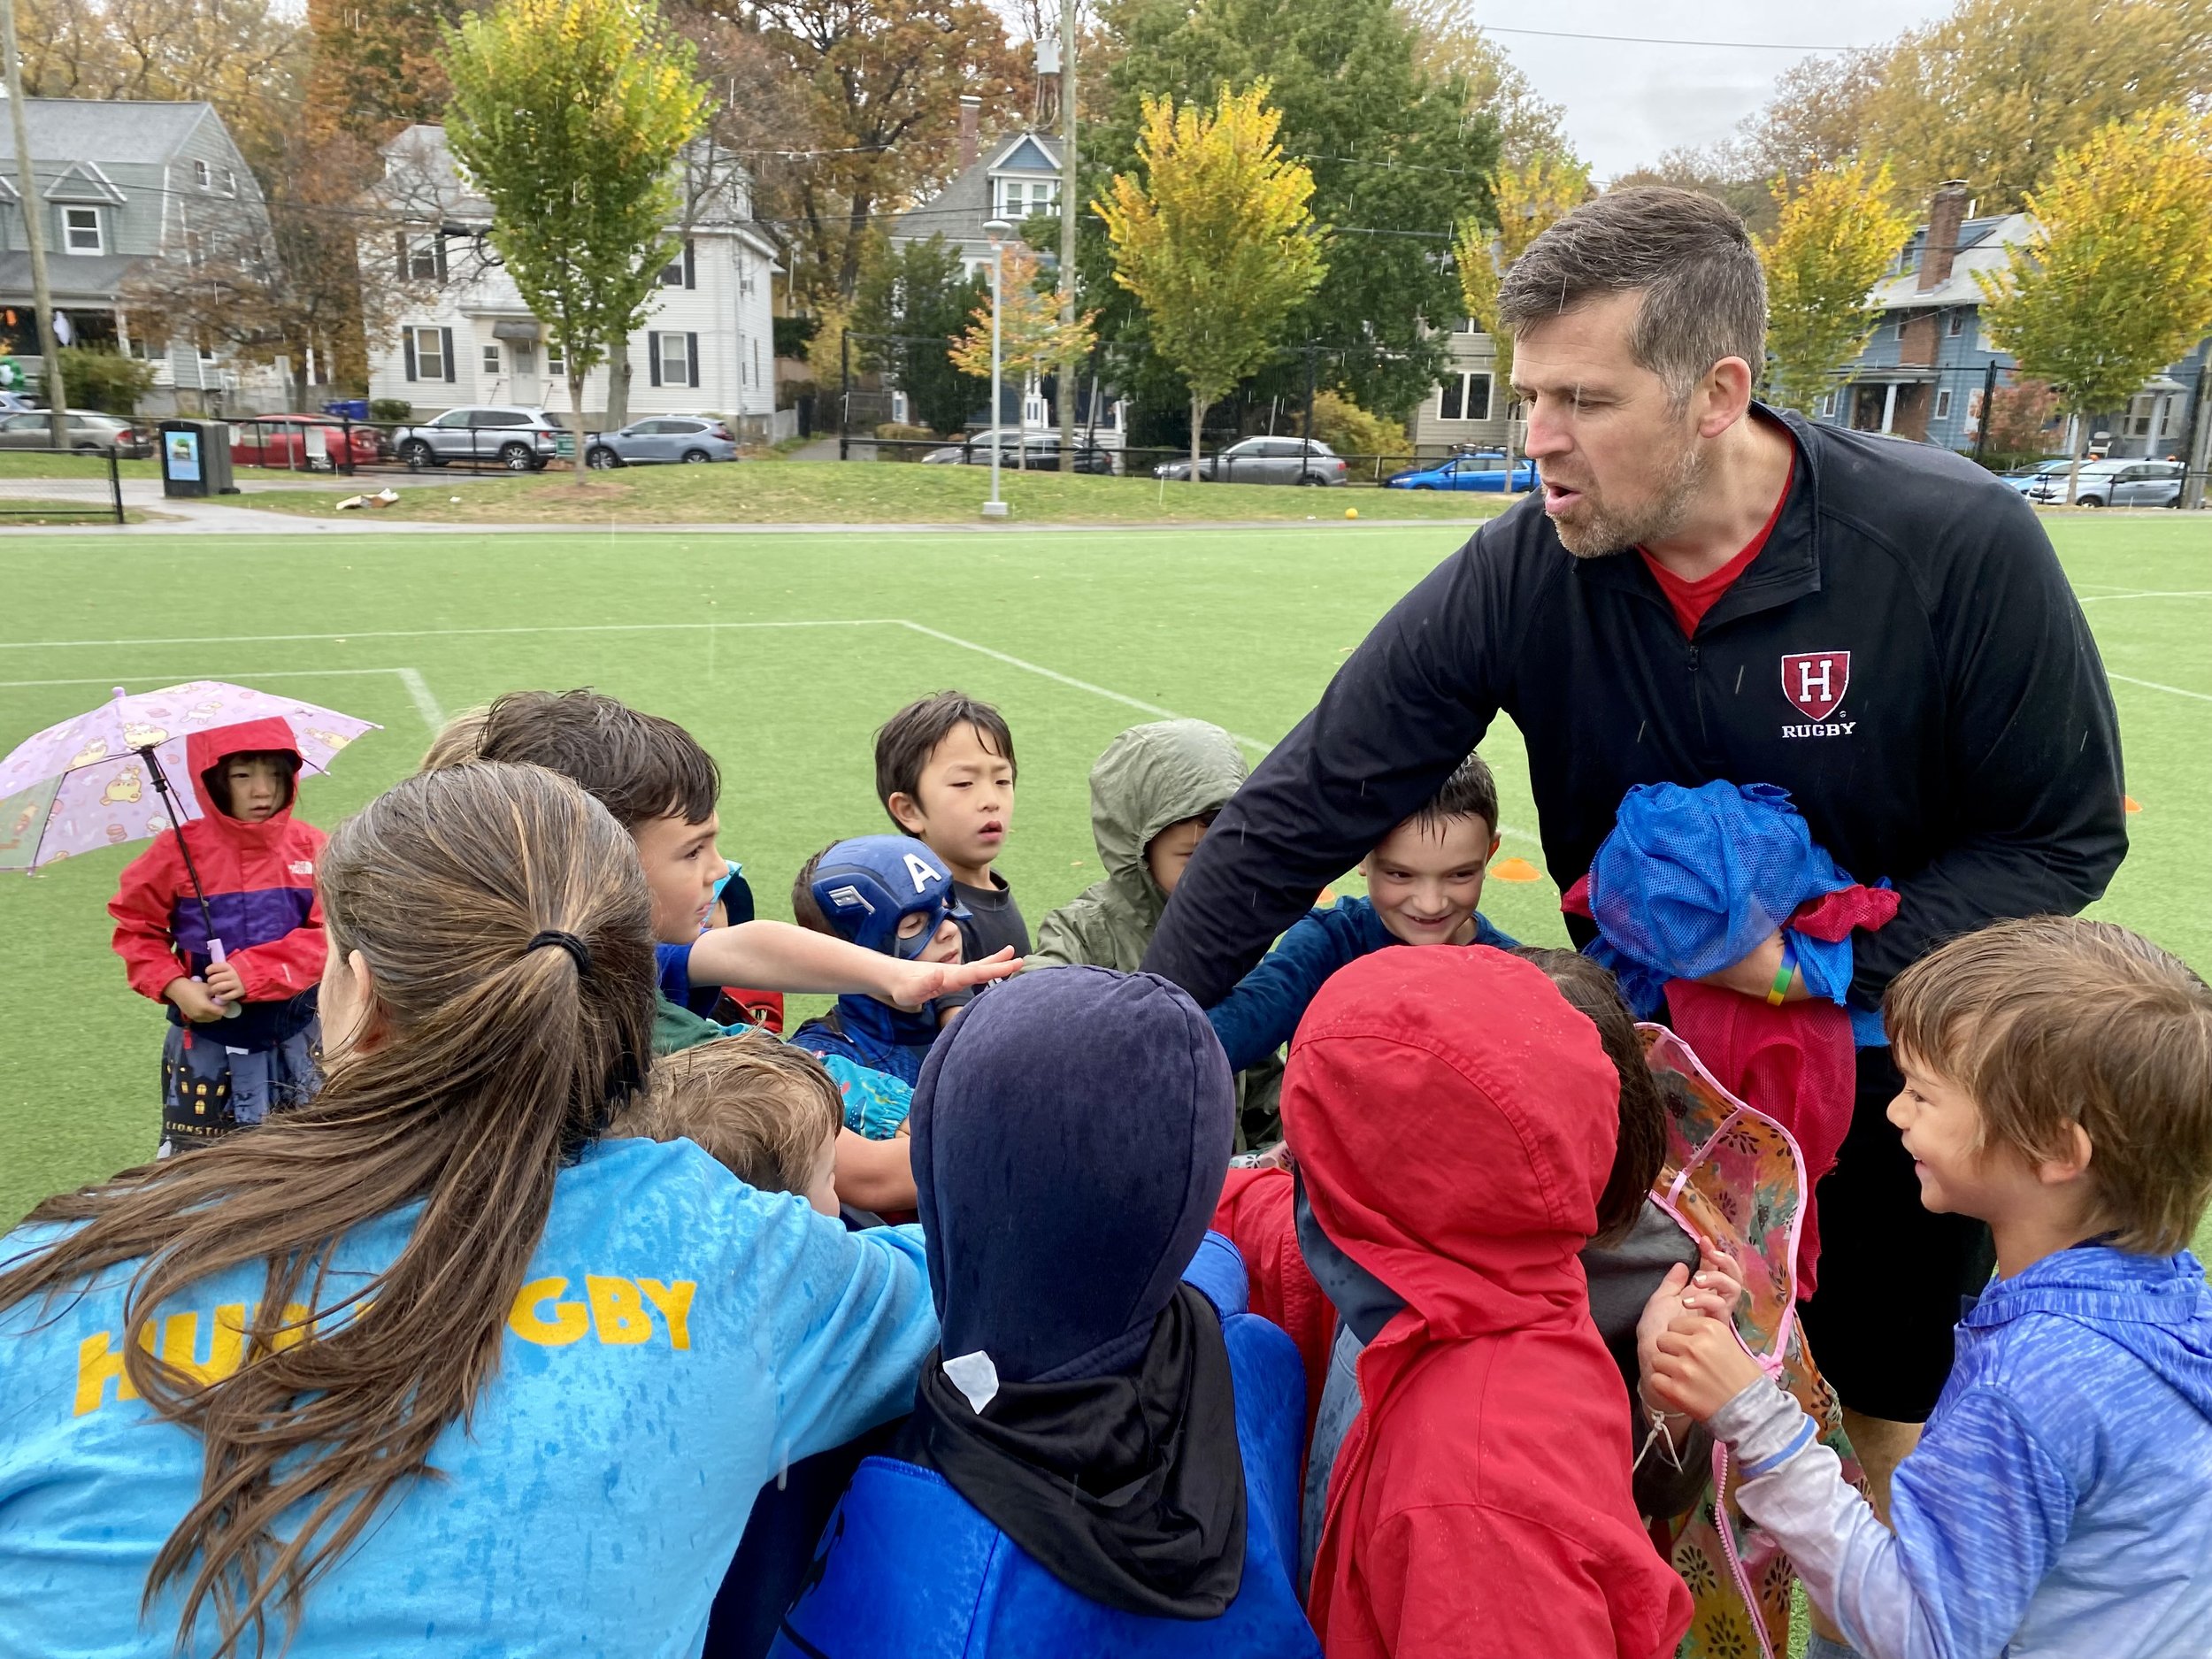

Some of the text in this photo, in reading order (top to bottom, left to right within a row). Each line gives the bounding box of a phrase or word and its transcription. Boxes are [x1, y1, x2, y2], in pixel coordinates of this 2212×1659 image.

[1798, 659, 1833, 703] H
[1781, 721, 1856, 739] RUGBY
[902, 853, 942, 894] A
